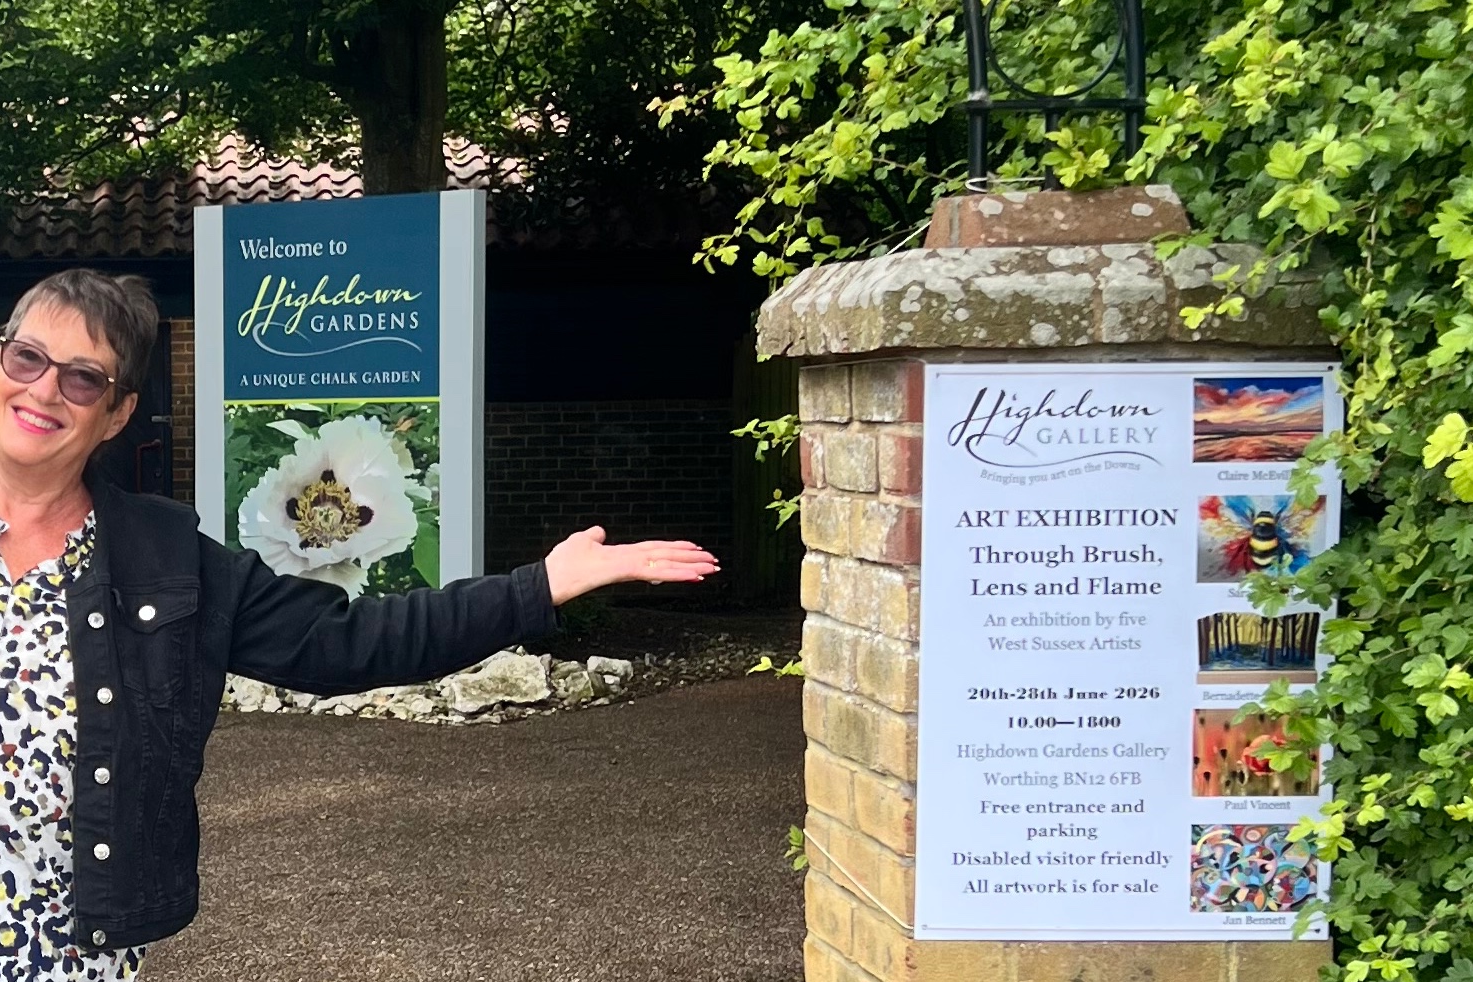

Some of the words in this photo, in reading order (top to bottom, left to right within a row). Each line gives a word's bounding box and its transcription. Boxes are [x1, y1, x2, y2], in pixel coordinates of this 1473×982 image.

[240, 238, 323, 261] Welcome
[329, 239, 347, 256] to
[237, 274, 422, 336] Highdown
[310, 312, 420, 333] GARDENS
[240, 375, 248, 386] A
[252, 373, 306, 387] UNIQUE
[310, 372, 357, 385] CHALK
[362, 371, 421, 384] GARDEN
[948, 387, 1163, 447] Highdown
[1036, 427, 1159, 445] GALLERY
[980, 469, 1026, 486] Bringing
[1028, 474, 1048, 486] you
[1050, 471, 1067, 481] art
[1068, 467, 1082, 477] on
[1084, 462, 1102, 473] the
[1104, 460, 1141, 471] Downs
[1217, 470, 1249, 480] Claire
[955, 510, 1009, 527] ART
[1017, 509, 1178, 527] EXHIBITION
[969, 545, 1074, 568] Through
[1083, 544, 1162, 565] Brush,
[971, 579, 1027, 595] Lens
[1034, 577, 1079, 595] and
[1088, 577, 1161, 594] Flame
[983, 614, 1006, 627] An
[1011, 611, 1091, 626] exhibition
[1095, 611, 1115, 630] by
[1118, 611, 1147, 626] five
[988, 637, 1027, 650] West
[1032, 637, 1085, 650] Sussex
[1089, 636, 1141, 650] Artists
[968, 688, 1057, 699] 20th-28th
[1064, 688, 1108, 699] June
[1115, 687, 1159, 699] 2026
[1202, 690, 1261, 701] Bernadette
[957, 743, 1038, 761] Highdown
[1043, 743, 1108, 758] Gardens
[1113, 743, 1170, 760] Gallery
[983, 771, 1059, 789] Worthing
[1063, 772, 1105, 785] BN12
[1110, 772, 1142, 785] 6FB
[981, 801, 1020, 813] Free
[1026, 802, 1105, 813] entrance
[1111, 799, 1144, 813] and
[1224, 801, 1247, 810] Paul
[1250, 800, 1291, 810] Vincent
[1027, 823, 1098, 840] parking
[953, 851, 1031, 865] Disabled
[1037, 852, 1095, 865] visitor
[1101, 851, 1172, 868] friendly
[964, 880, 988, 893] All
[994, 879, 1067, 893] artwork
[1073, 880, 1086, 892] is
[1093, 879, 1119, 893] for
[1124, 879, 1158, 892] sale
[1223, 916, 1242, 925] Jan
[1245, 916, 1286, 925] Bennett
